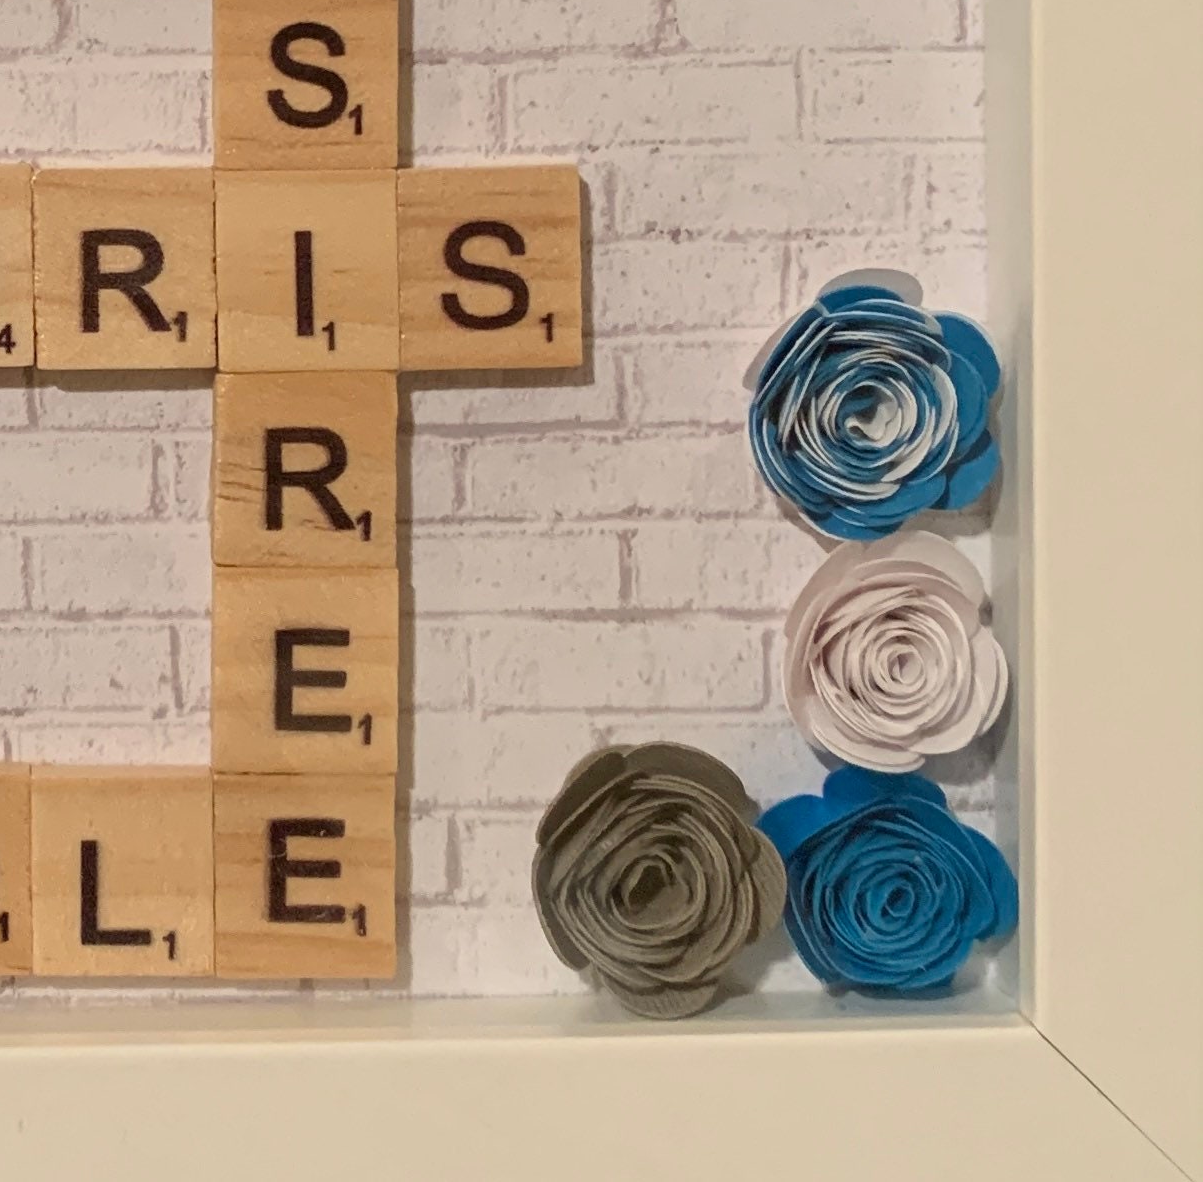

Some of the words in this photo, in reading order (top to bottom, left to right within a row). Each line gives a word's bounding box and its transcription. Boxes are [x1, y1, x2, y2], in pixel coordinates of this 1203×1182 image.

[347, 104, 364, 136] 1
[171, 311, 189, 342] 1
[320, 321, 337, 352] 1
[538, 312, 556, 343] 1
[354, 510, 374, 542] 1
[356, 713, 374, 745] 1
[161, 931, 178, 960] 1
[350, 904, 369, 937] 1
